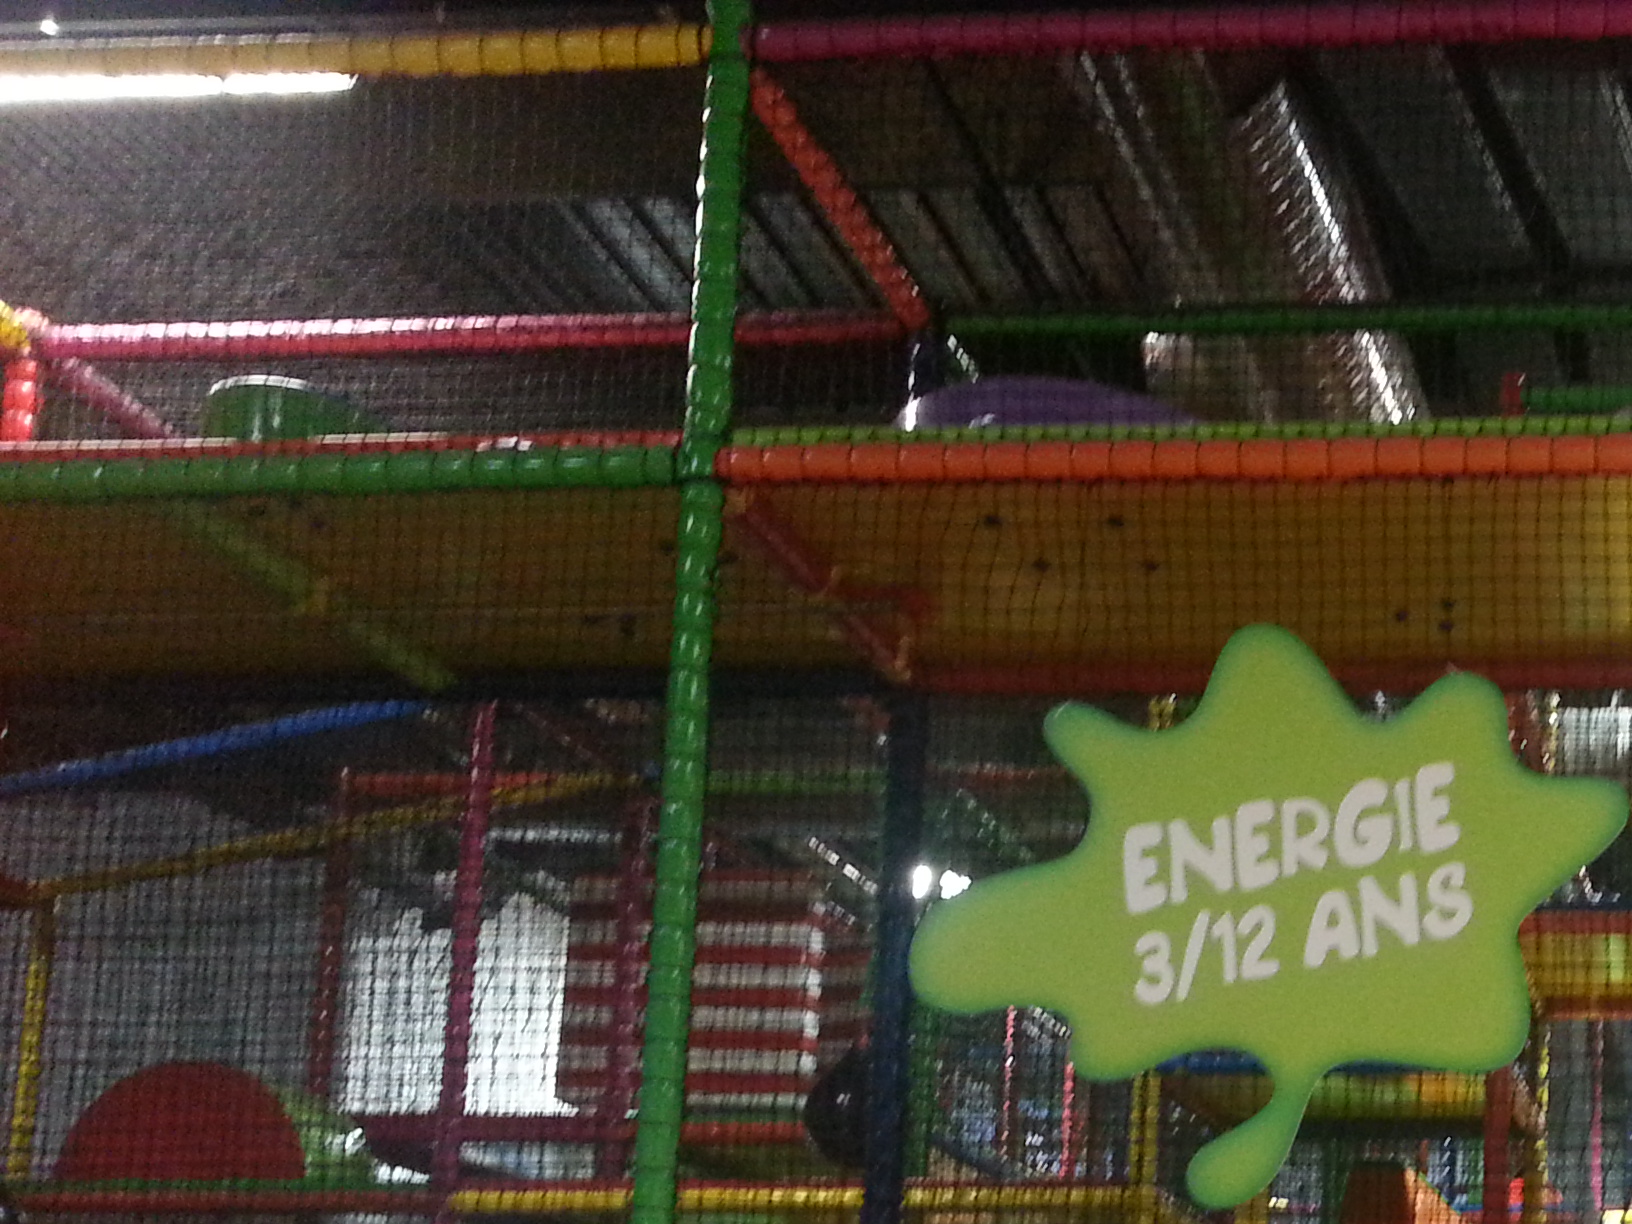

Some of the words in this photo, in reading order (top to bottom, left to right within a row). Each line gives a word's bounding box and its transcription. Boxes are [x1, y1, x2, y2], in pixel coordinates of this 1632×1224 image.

[1122, 761, 1462, 914] ENERGIE
[1133, 906, 1279, 1005] 3/12
[1304, 862, 1474, 968] ANS
